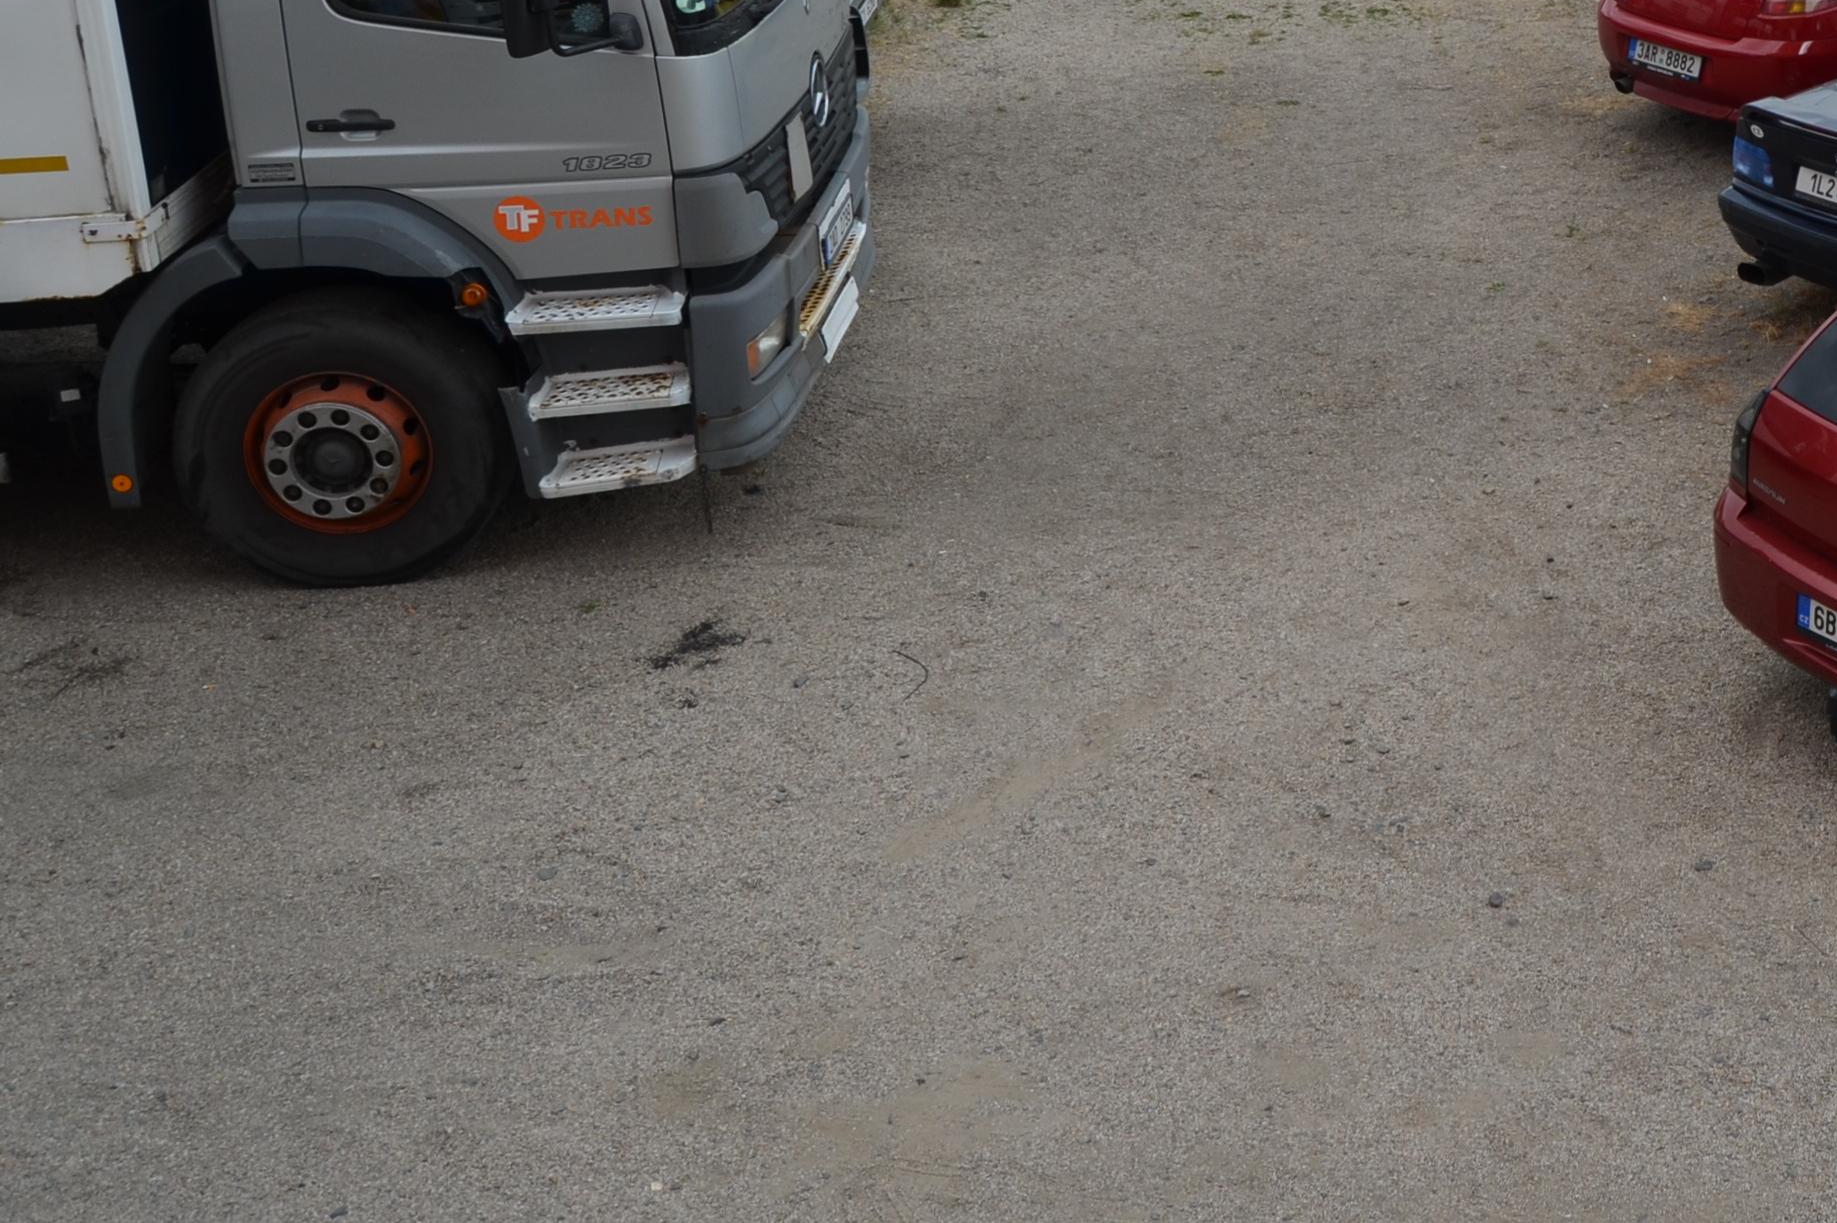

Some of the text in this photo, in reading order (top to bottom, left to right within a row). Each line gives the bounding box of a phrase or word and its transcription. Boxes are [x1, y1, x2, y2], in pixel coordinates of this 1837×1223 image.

[1637, 42, 1658, 63] 3AR
[1665, 50, 1696, 74] 8882
[562, 153, 652, 172] 1823
[1810, 173, 1836, 198] 1L2
[549, 205, 654, 230] TRANS
